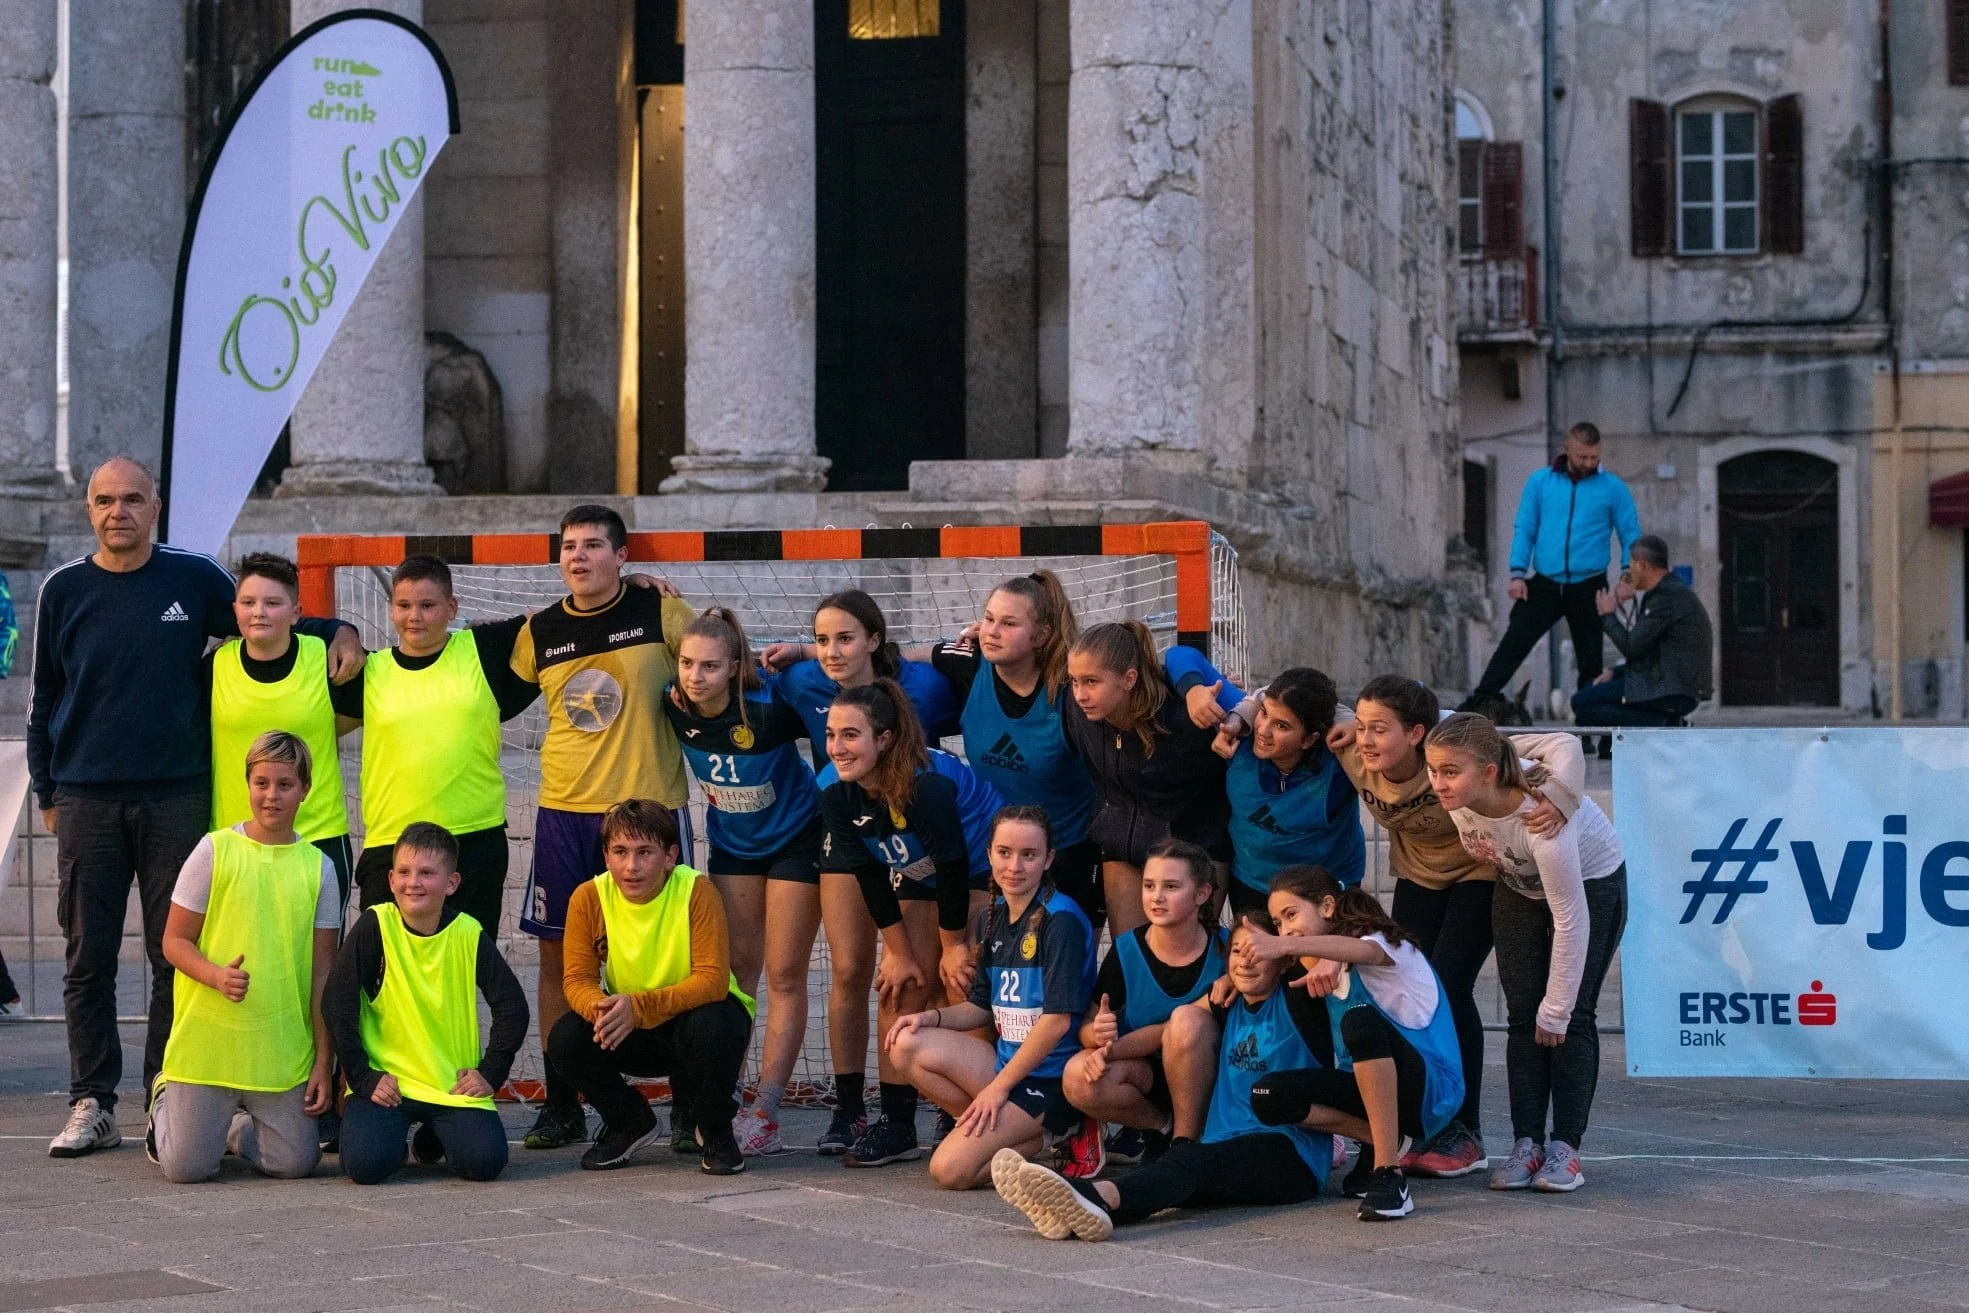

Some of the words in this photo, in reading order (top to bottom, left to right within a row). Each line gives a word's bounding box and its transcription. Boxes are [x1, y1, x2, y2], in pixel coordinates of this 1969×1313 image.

[313, 57, 355, 73] run
[323, 80, 363, 98] eat
[308, 100, 376, 123] drink
[608, 627, 644, 644] SPORTLAND
[708, 753, 740, 784] 21
[878, 834, 909, 864] 19
[1679, 814, 1969, 951] #vje
[1000, 970, 1021, 1002] 22
[1001, 1011, 1041, 1027] PEHARE
[1679, 992, 1791, 1025] ERSTE
[1680, 1029, 1726, 1047] Bank
